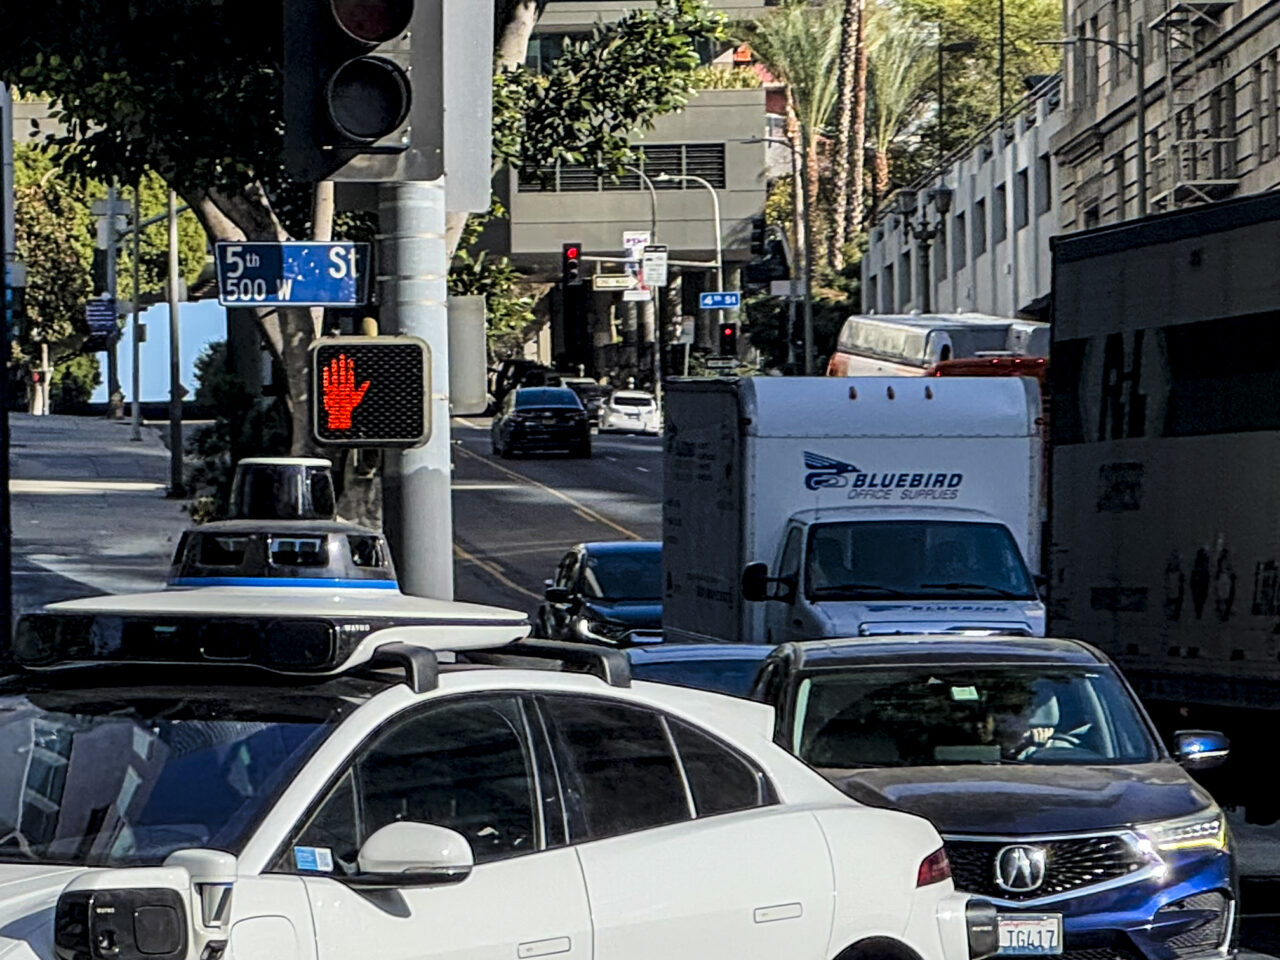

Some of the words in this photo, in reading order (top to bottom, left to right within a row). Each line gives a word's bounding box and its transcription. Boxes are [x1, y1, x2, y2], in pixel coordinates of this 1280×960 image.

[226, 246, 260, 278] 5th
[329, 246, 360, 279] St
[226, 279, 266, 301] 500
[276, 278, 293, 301] W
[851, 473, 964, 488] BLUEBIRD
[847, 489, 892, 500] OFFICE
[899, 489, 960, 500] SUPPLIES
